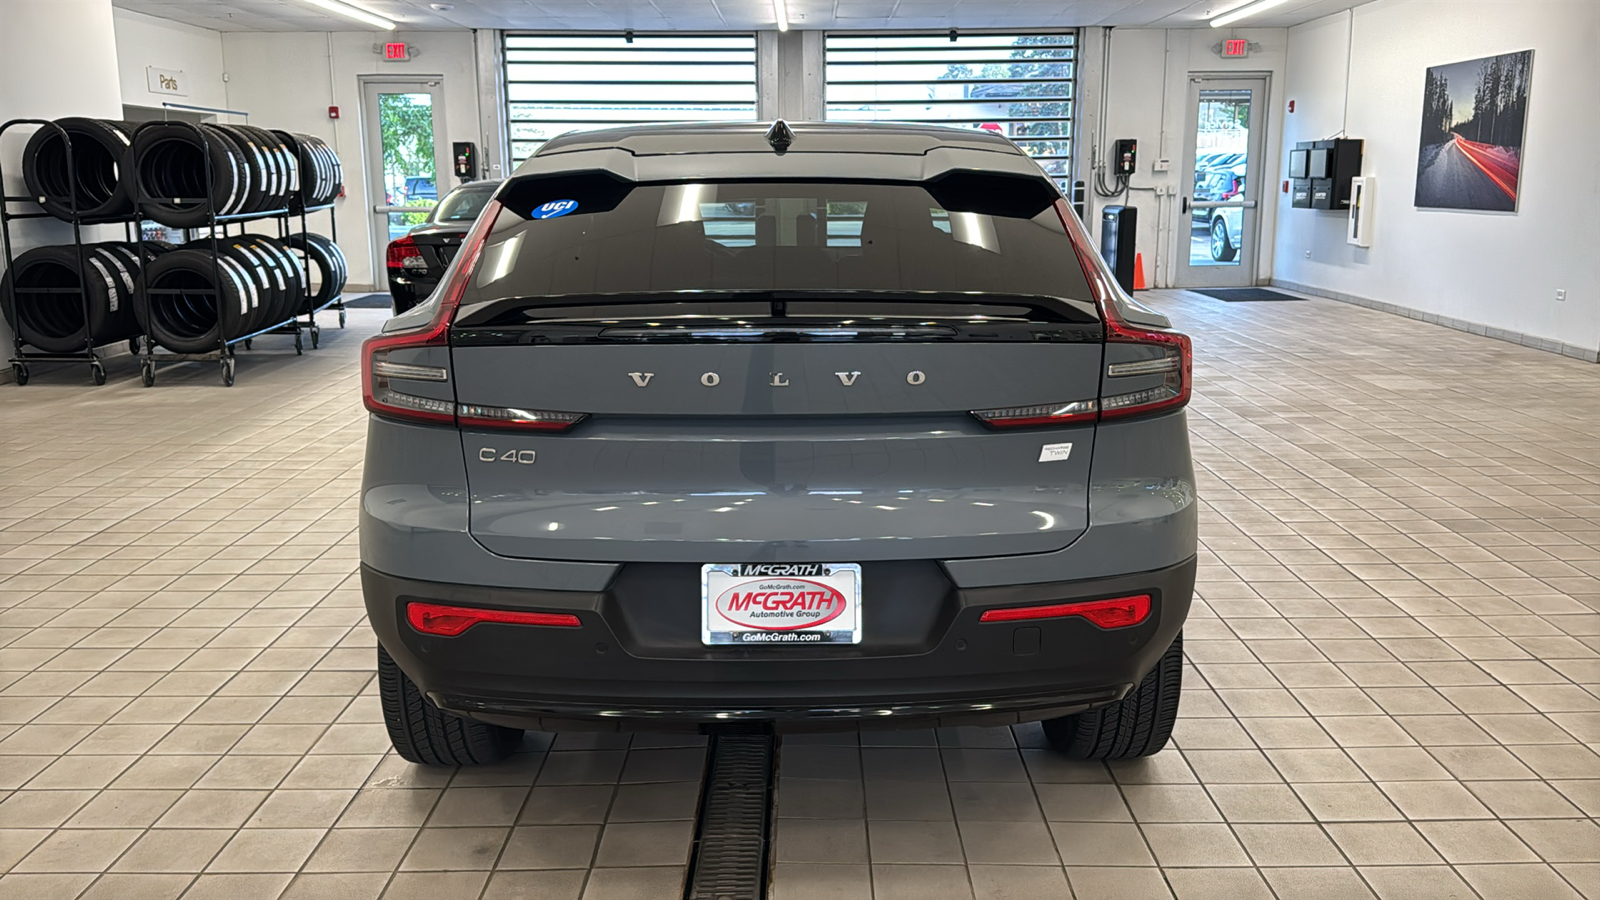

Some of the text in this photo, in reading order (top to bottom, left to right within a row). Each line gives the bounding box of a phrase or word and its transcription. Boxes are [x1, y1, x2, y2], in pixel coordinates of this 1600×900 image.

[386, 42, 406, 59] EXIT
[1226, 39, 1246, 56] EXIT
[159, 74, 178, 91] Parts
[541, 200, 575, 212] UCI
[628, 370, 927, 388] VOLVO
[479, 447, 536, 464] C40
[795, 610, 821, 618] Group
[742, 633, 821, 642] GoMcGrath.com
